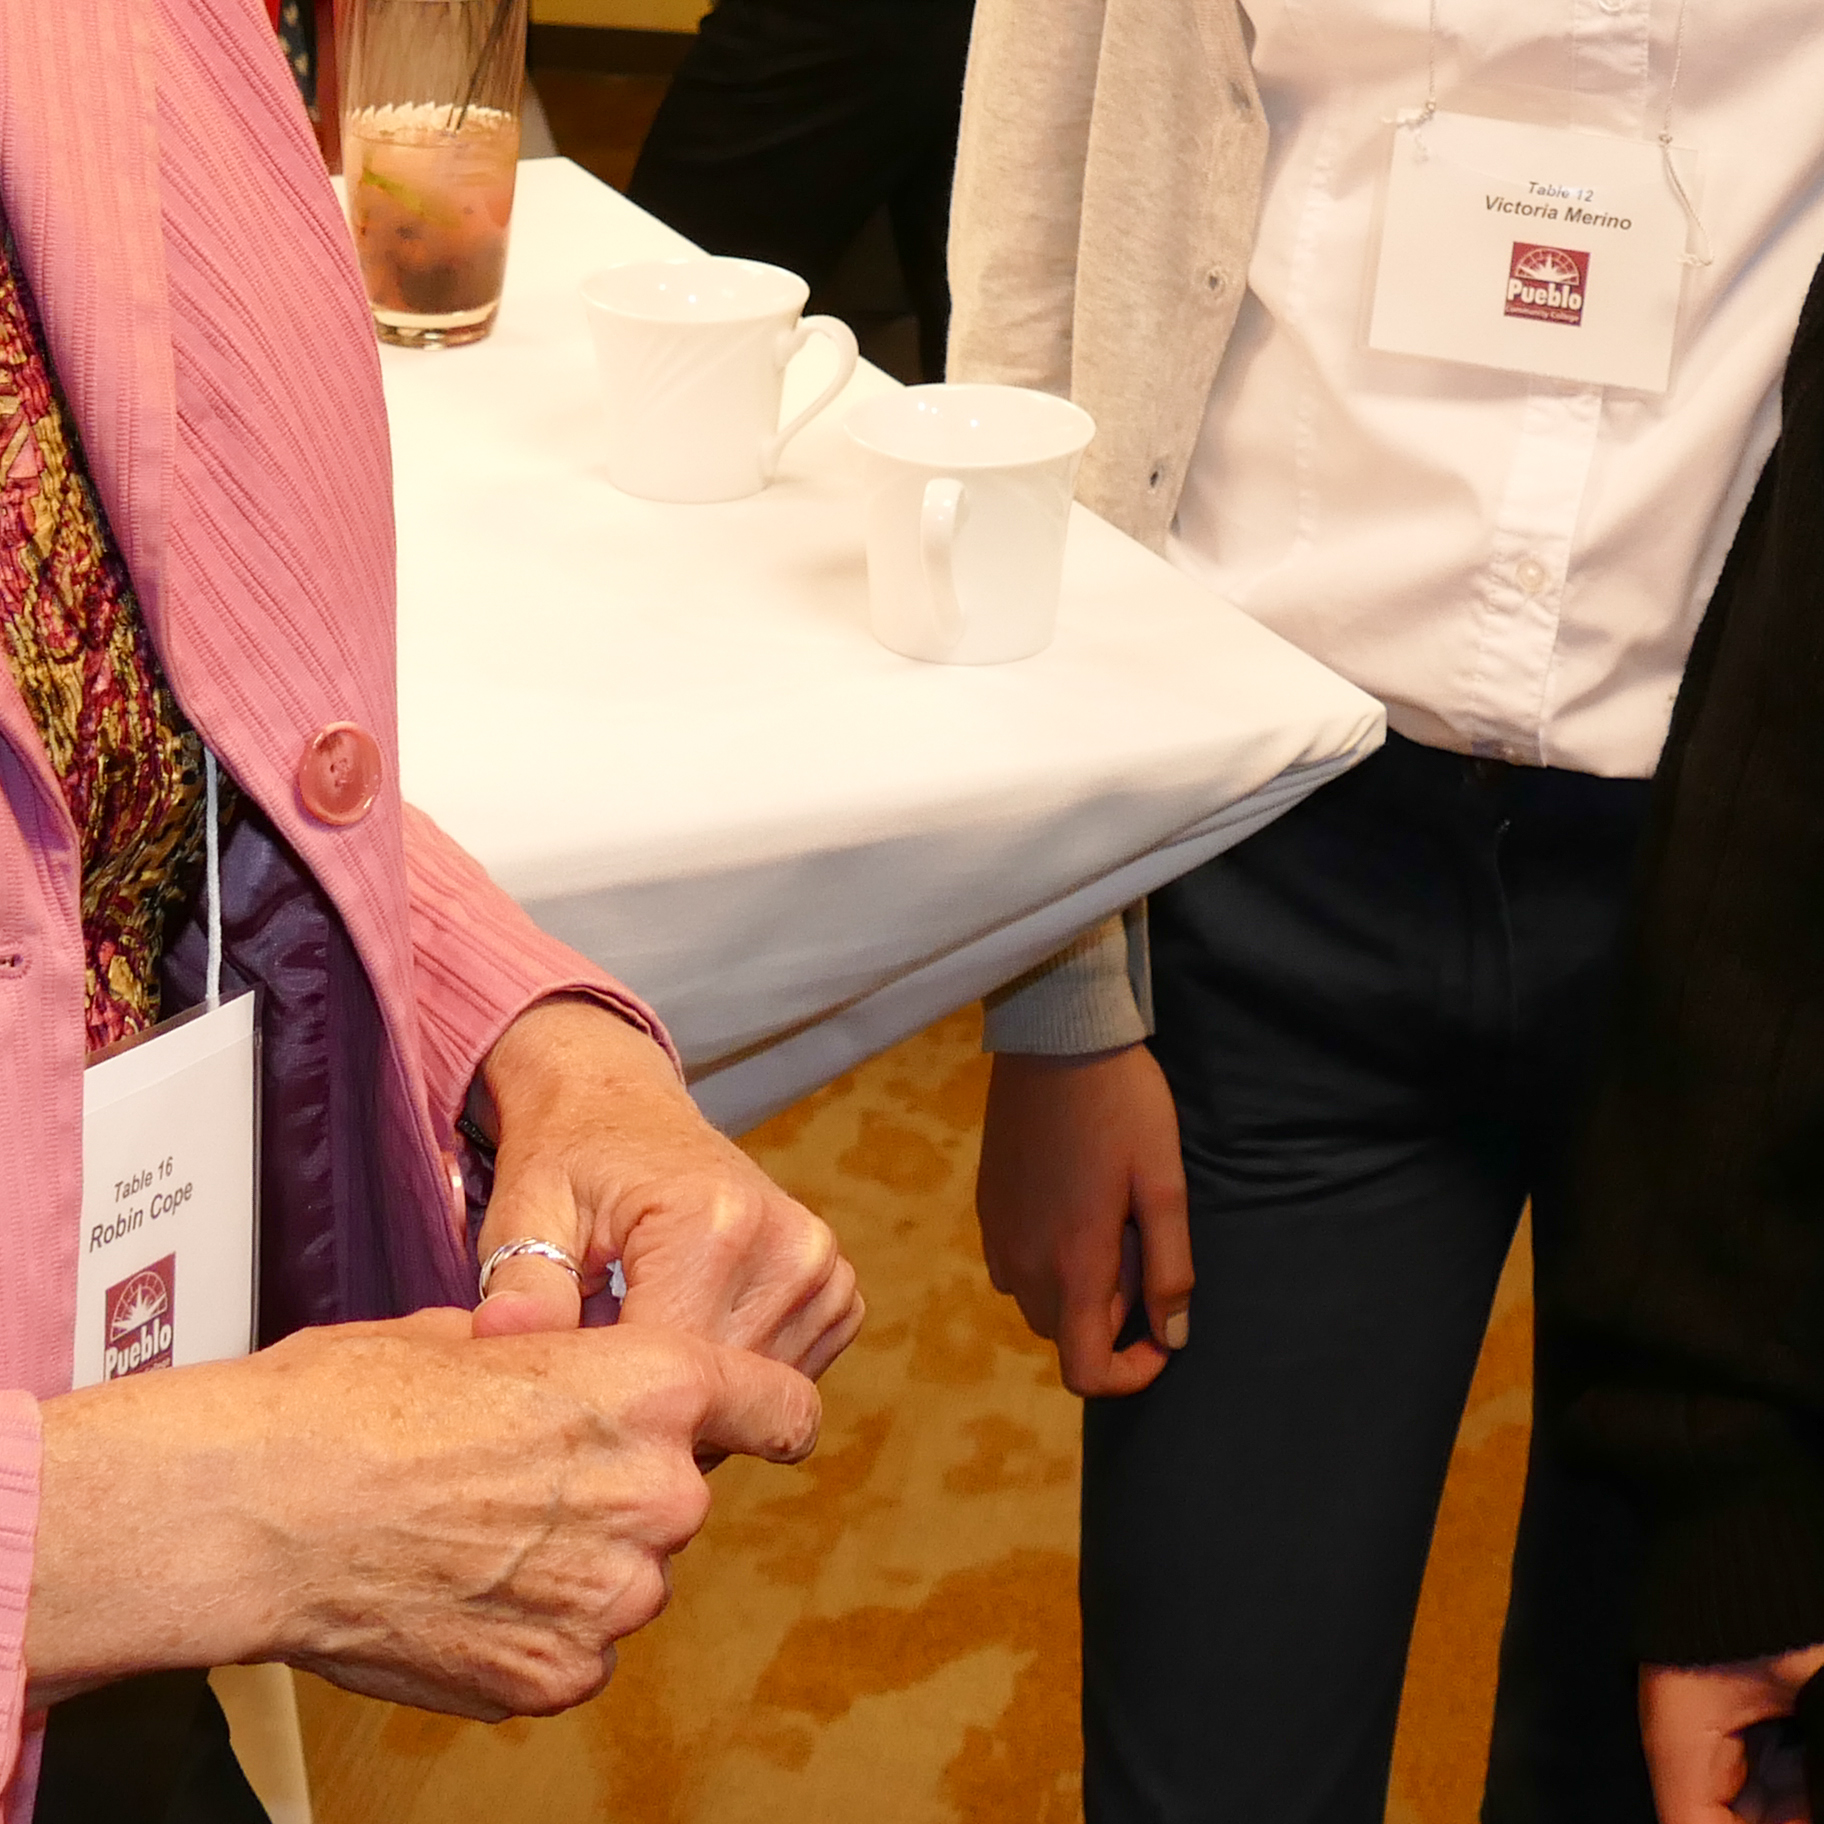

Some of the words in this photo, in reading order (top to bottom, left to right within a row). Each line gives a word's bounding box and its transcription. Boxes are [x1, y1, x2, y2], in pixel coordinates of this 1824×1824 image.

[1485, 194, 1559, 221] Victoria
[1564, 206, 1633, 231] Merino
[1528, 181, 1571, 199] Table
[1577, 188, 1594, 203] 12
[1507, 277, 1582, 310] Pueblo
[114, 1169, 153, 1203] Table
[158, 1155, 174, 1181] 16
[89, 1207, 144, 1254] Robin
[150, 1182, 193, 1219] Cope
[105, 1317, 172, 1380] Pueblo
